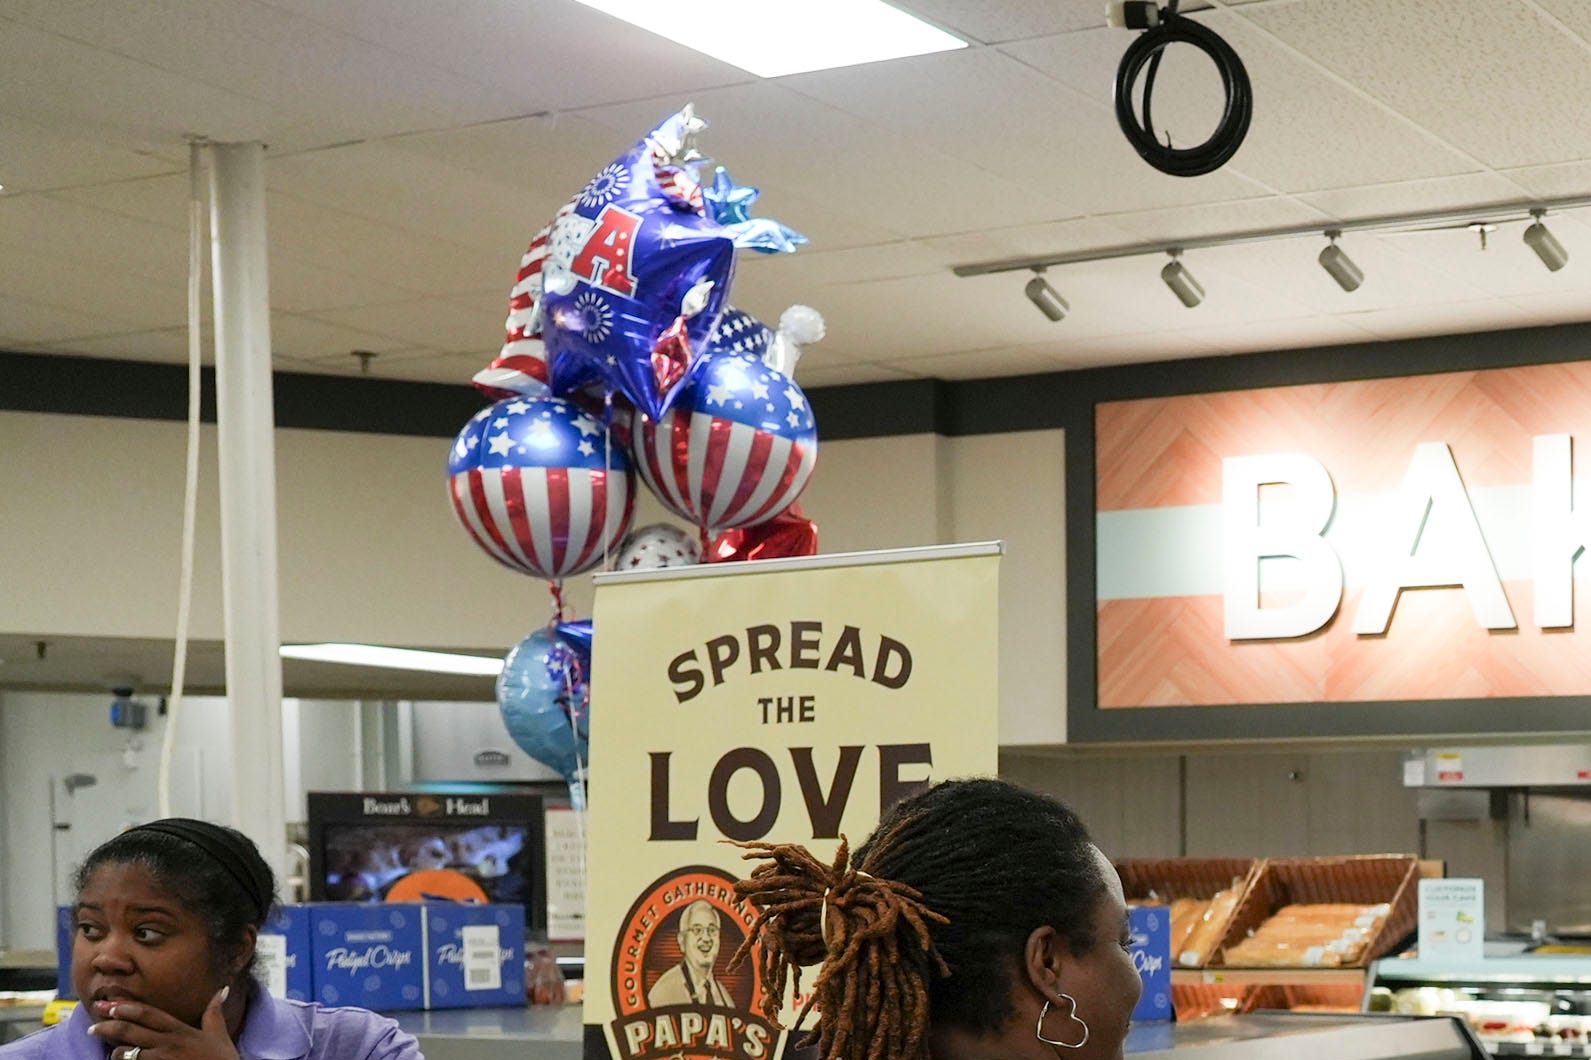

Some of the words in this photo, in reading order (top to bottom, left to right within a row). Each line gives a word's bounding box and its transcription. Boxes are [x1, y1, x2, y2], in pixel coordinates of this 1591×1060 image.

[667, 621, 913, 703] SPREAD
[757, 695, 816, 725] THE
[446, 799, 490, 815] Head
[648, 743, 934, 842] LOVE
[624, 904, 660, 1009] GOURMET
[624, 1012, 769, 1059] PAPA'S
